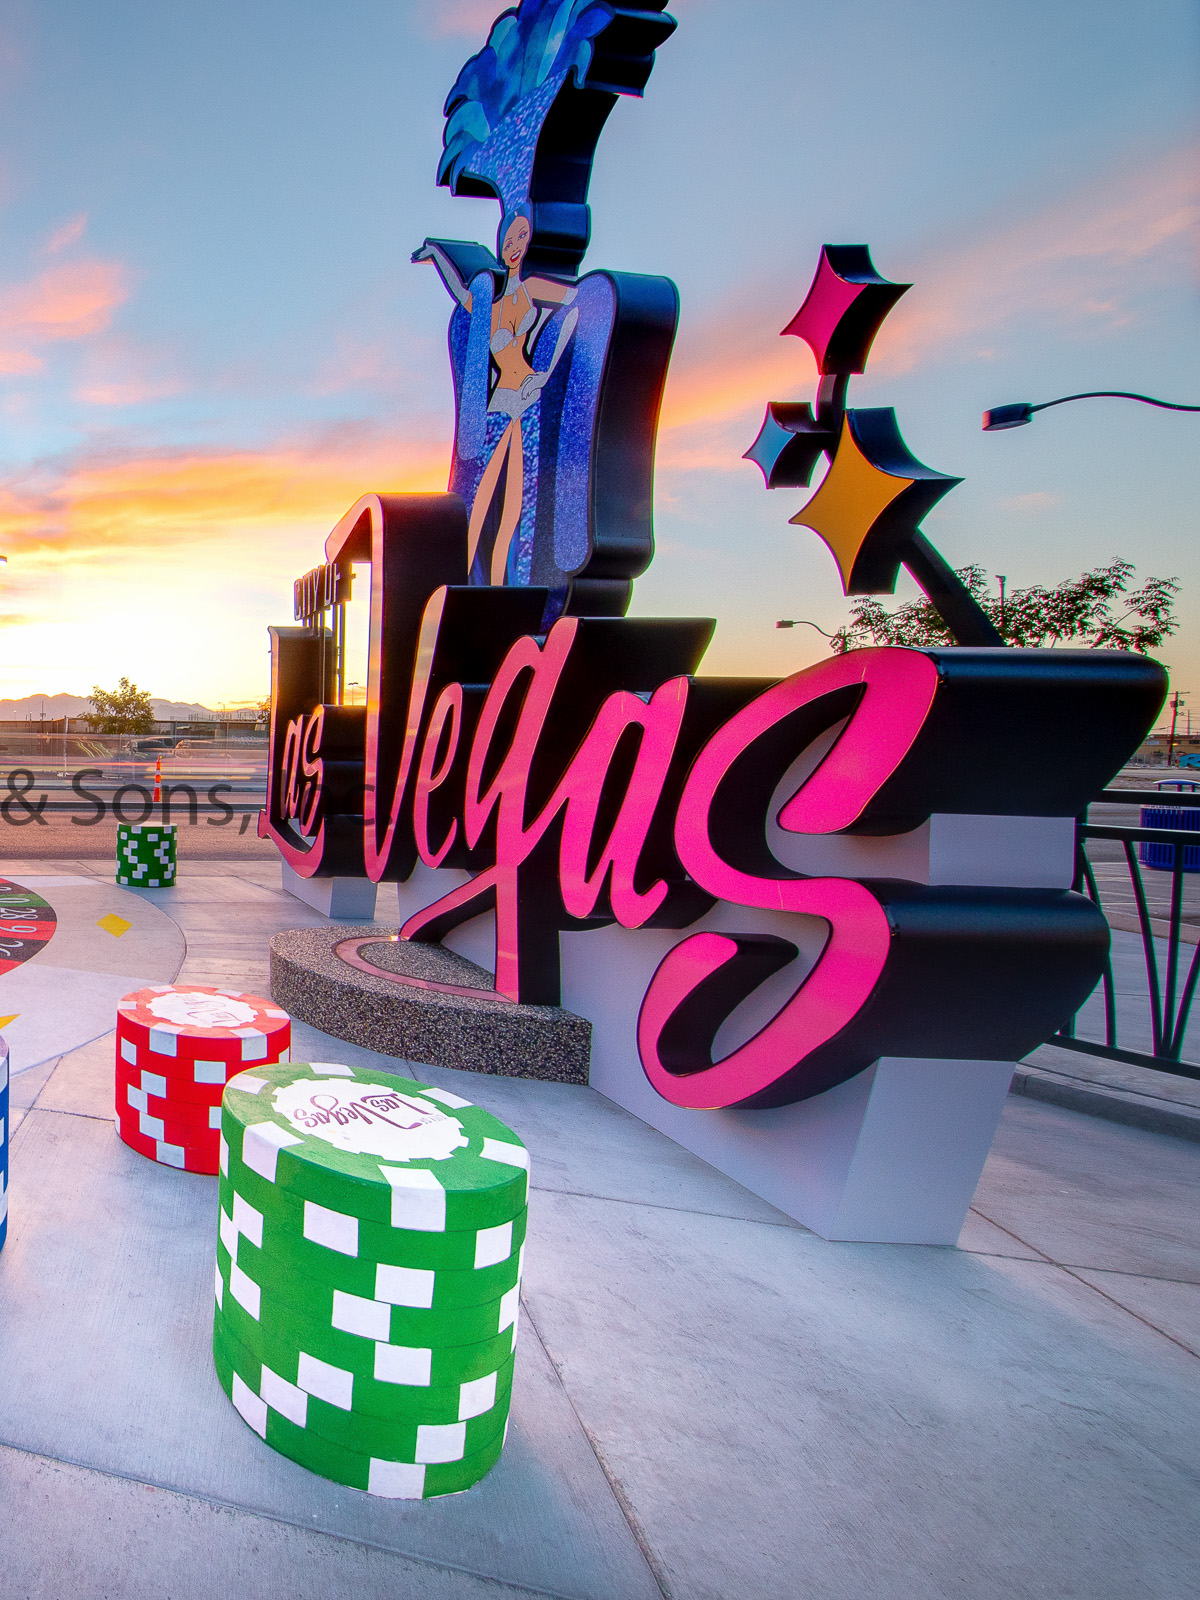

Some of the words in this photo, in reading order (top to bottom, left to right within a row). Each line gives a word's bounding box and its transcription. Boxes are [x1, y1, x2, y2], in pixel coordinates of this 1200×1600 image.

[325, 492, 942, 1110] Vegas
[0, 907, 39, 920] 28
[293, 1094, 423, 1130] Vegas
[360, 1093, 434, 1116] Las
